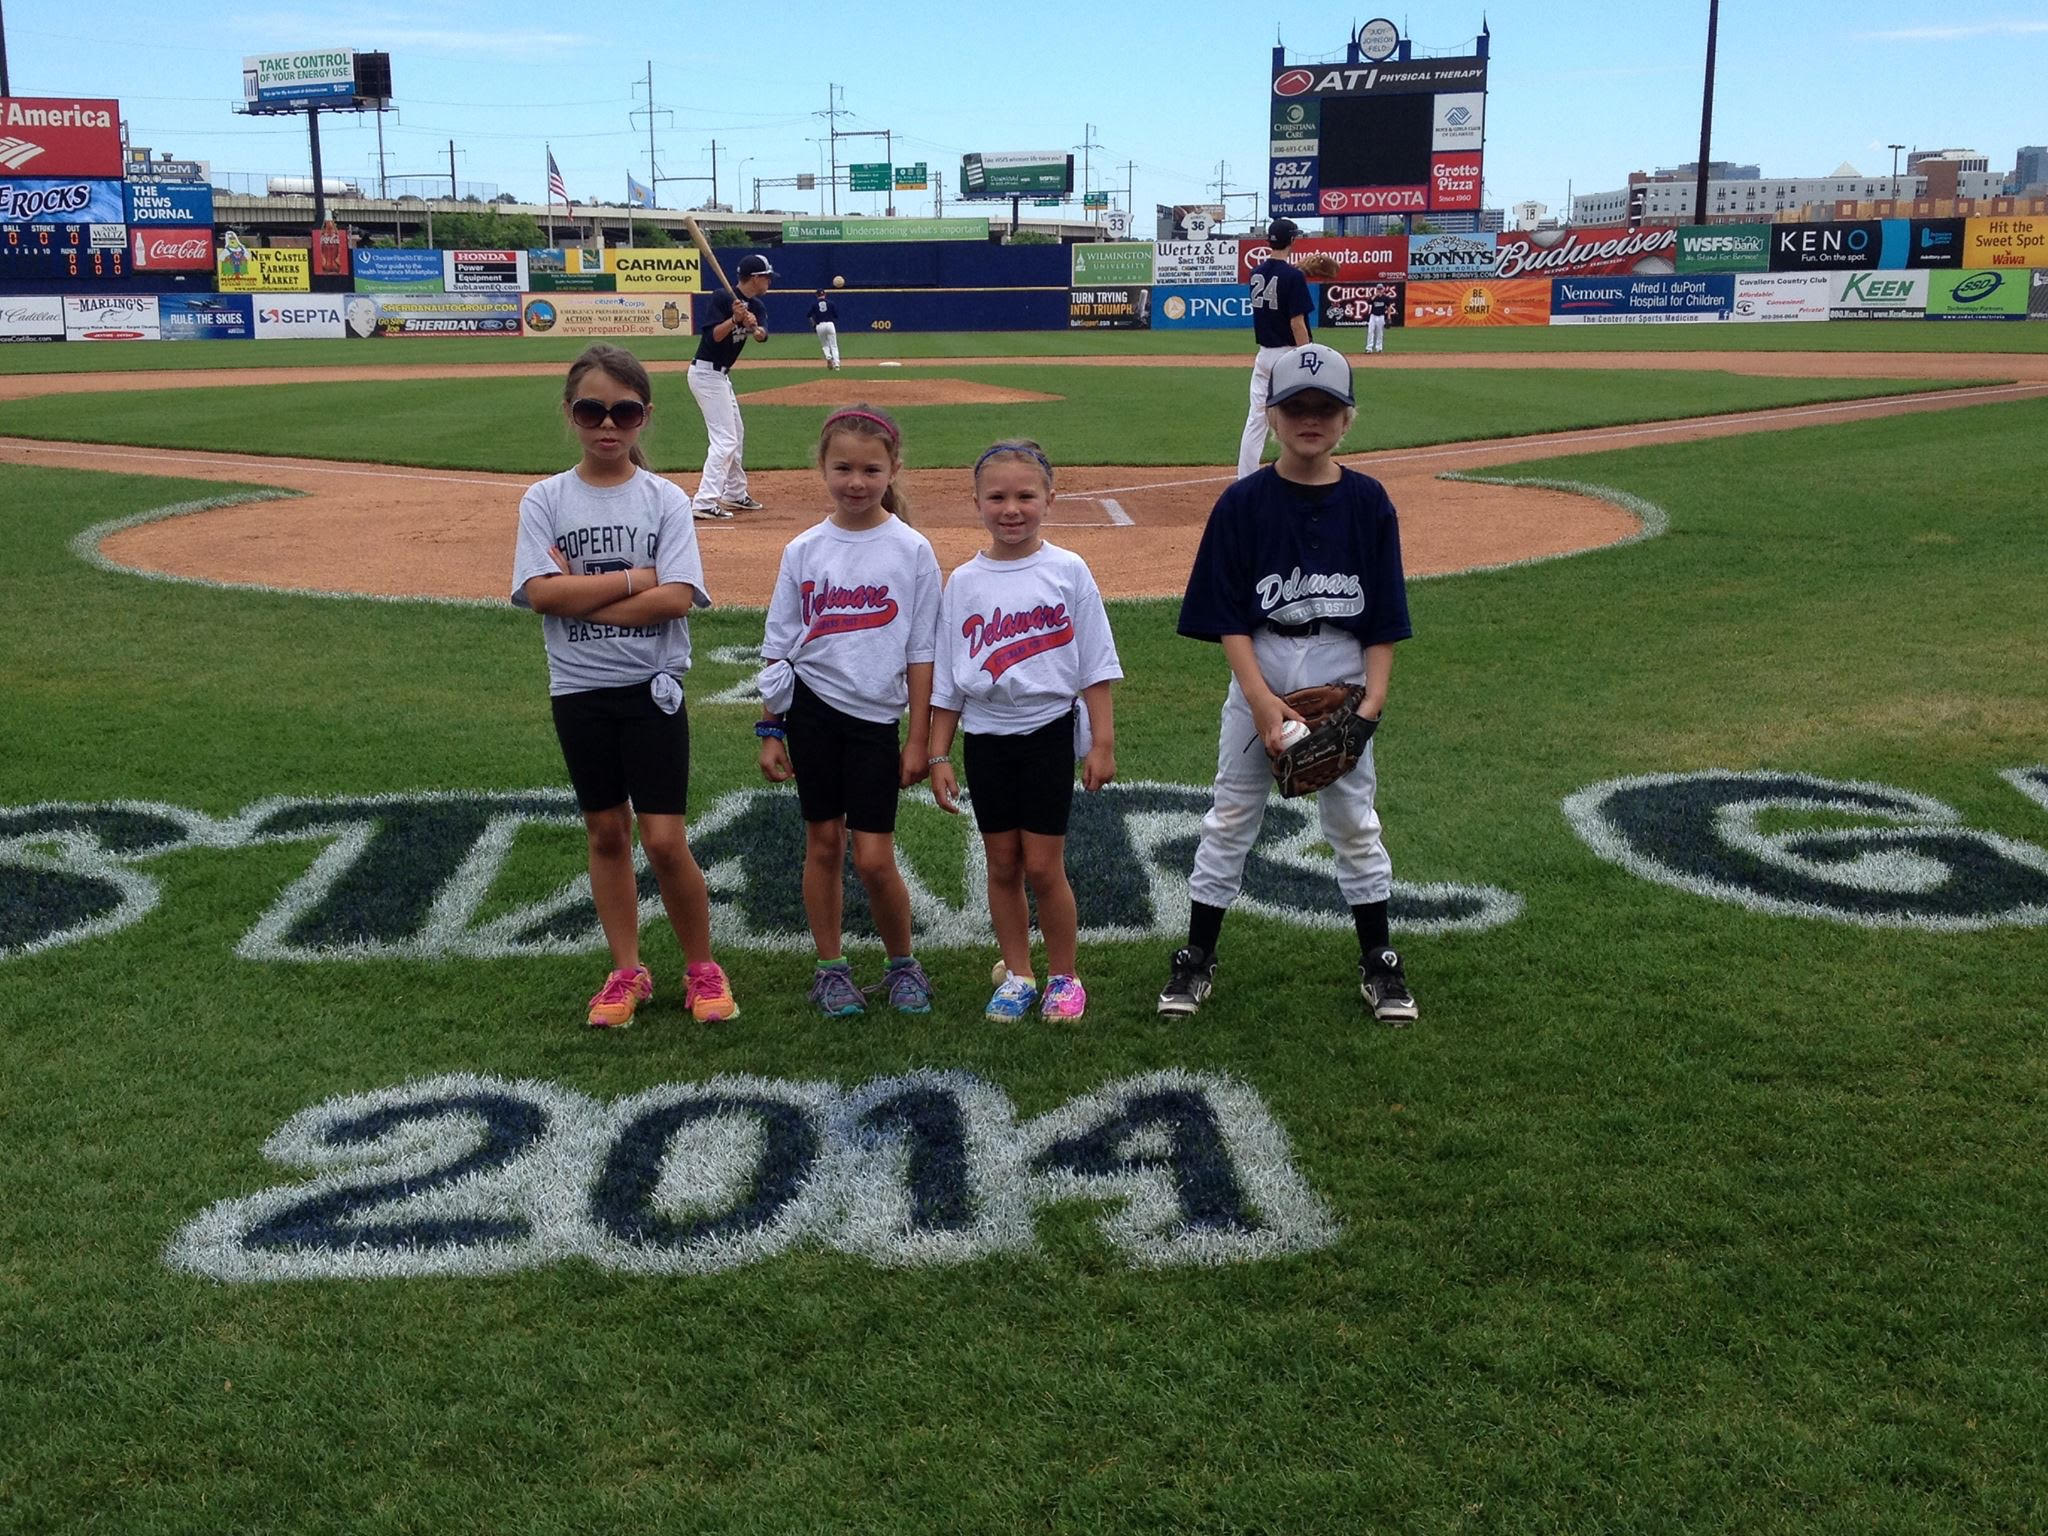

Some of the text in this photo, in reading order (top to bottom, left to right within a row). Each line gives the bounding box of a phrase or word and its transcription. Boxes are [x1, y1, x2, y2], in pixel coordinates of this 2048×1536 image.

[1363, 36, 1393, 44] JOHNSON
[259, 53, 350, 72] TAKE CONTROL
[260, 74, 270, 83] OF
[272, 71, 295, 81] YOUR
[297, 69, 329, 80] ENERGY
[1314, 69, 1483, 91] ATI PHYSICAL THERAPY
[8, 102, 111, 127] America
[1274, 123, 1316, 131] CHRISTIANA
[130, 165, 191, 173] 21 MCM
[1275, 162, 1312, 176] 93.7
[1434, 164, 1479, 177] Grotto
[1273, 176, 1313, 190] WSTW
[1437, 177, 1473, 191] Pizza
[132, 186, 158, 196] THE
[10, 185, 90, 218] ROCKS
[134, 197, 171, 207] NEWS
[1351, 191, 1425, 207] TOYOTA
[1271, 202, 1315, 212] wstw.com
[133, 209, 193, 221] JOURNAL
[819, 228, 840, 236] Bank
[846, 224, 912, 236] Understanding
[914, 223, 938, 234] what's
[941, 224, 982, 236] important
[1110, 219, 1124, 230] 33
[1191, 221, 1205, 230] 36
[1989, 221, 2033, 233] Hit the
[1683, 237, 1763, 252] WSFS bank
[1781, 229, 1868, 252] KENO
[1975, 234, 2045, 248] Sweet Spot
[150, 239, 209, 259] Coca-Cola
[1158, 241, 1238, 256] Wertz & Co.
[1496, 228, 1678, 279] Budweiser
[457, 252, 508, 261] HONDA
[1087, 251, 1151, 261] WILMINGTON
[1196, 256, 1215, 264] 1926
[1410, 250, 1495, 266] RONNY'S
[1801, 253, 1867, 262] Fun. On the spot.
[1992, 254, 2025, 265] Wawa
[260, 262, 300, 273] FARMERS
[458, 264, 484, 272] Power
[616, 259, 699, 271] CARMAN
[263, 274, 298, 285] MARKET
[458, 274, 502, 283] Equipment
[625, 274, 692, 283] Auto Group
[1777, 277, 1807, 286] Country
[453, 284, 521, 292] SubLawnEQ.com
[1251, 273, 1279, 310] 24
[1631, 282, 1660, 294] Alfred
[1671, 281, 1706, 293] duPont
[1840, 272, 1915, 302] KEEN
[1071, 292, 1128, 303] TURN TRYING
[1472, 289, 1482, 298] BE
[79, 298, 145, 313] MARLING'S
[595, 297, 620, 305] citizen
[1469, 297, 1486, 306] SUN
[1629, 294, 1725, 309] Hospital for Children
[382, 304, 517, 312] SHERIDANAUTOGROUP.COM
[1070, 304, 1135, 315] INTO TRIUMPH.
[1345, 303, 1355, 314] &
[1464, 305, 1490, 315] SMART
[5, 308, 60, 323] Cadillac
[170, 312, 245, 325] RULE THE SKIES.
[281, 309, 340, 323] SEPTA
[1598, 315, 1623, 323] Center
[1638, 314, 1662, 324] Sports
[1665, 314, 1699, 322] Medicine
[378, 318, 390, 327] Go
[405, 320, 478, 331] SHERIDAN
[871, 320, 892, 329] 400
[1298, 351, 1324, 377] DV
[557, 524, 639, 560] ROPERTY
[1256, 566, 1360, 610] Delaware
[961, 602, 1067, 660] Delaware
[180, 1075, 1325, 1275] 2014
